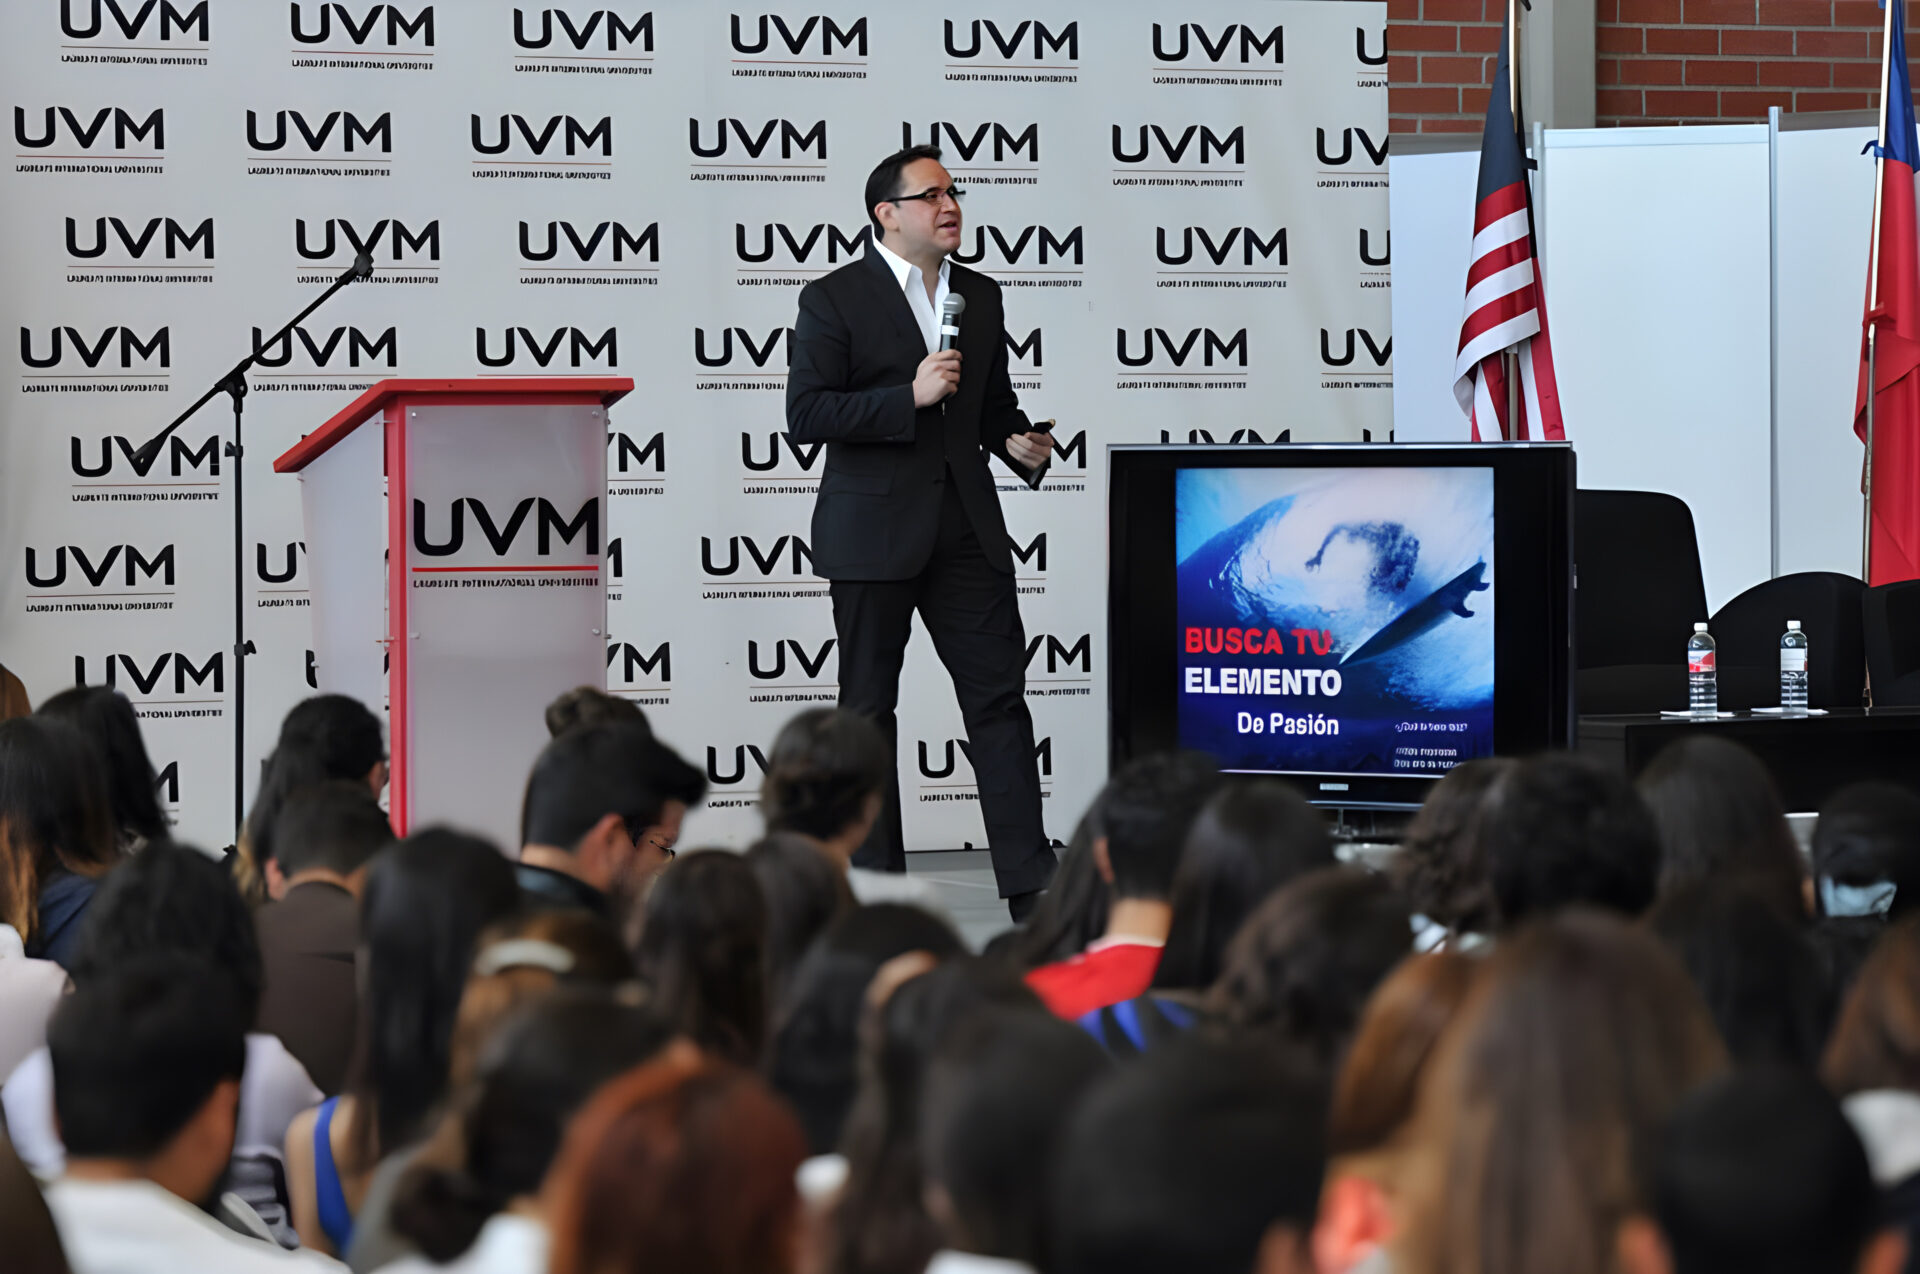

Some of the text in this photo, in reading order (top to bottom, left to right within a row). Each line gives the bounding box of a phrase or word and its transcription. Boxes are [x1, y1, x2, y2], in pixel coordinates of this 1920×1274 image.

[61, 0, 208, 41] UVM
[291, 3, 434, 46] UVM
[514, 8, 653, 51] UVM
[731, 13, 867, 56] UVM
[945, 18, 1078, 60] UVM
[1153, 23, 1283, 63] UVM
[15, 106, 164, 149] UVM
[247, 110, 392, 152] UVM
[472, 113, 611, 156] UVM
[690, 118, 826, 160] UVM
[1113, 124, 1244, 164] UVM
[1317, 127, 1389, 165] UV
[66, 217, 214, 259] UVM
[296, 219, 439, 260] UVM
[519, 221, 658, 262] UVM
[736, 223, 871, 263] UVM
[1157, 227, 1287, 266] UVM
[21, 327, 169, 368] UVM
[252, 327, 396, 368] UVM
[477, 327, 617, 367] UVM
[695, 328, 795, 367] UV
[1118, 328, 1247, 366] UVM
[1321, 328, 1392, 366] UV
[71, 435, 219, 478] UVM
[742, 432, 818, 472] UV
[413, 497, 599, 557] UVM
[26, 544, 174, 588] UVM
[748, 639, 838, 679] UV
[1186, 628, 1333, 656] BUSCA TU
[1185, 667, 1342, 697] ELEMENTO
[1237, 711, 1339, 735] De Pasión
